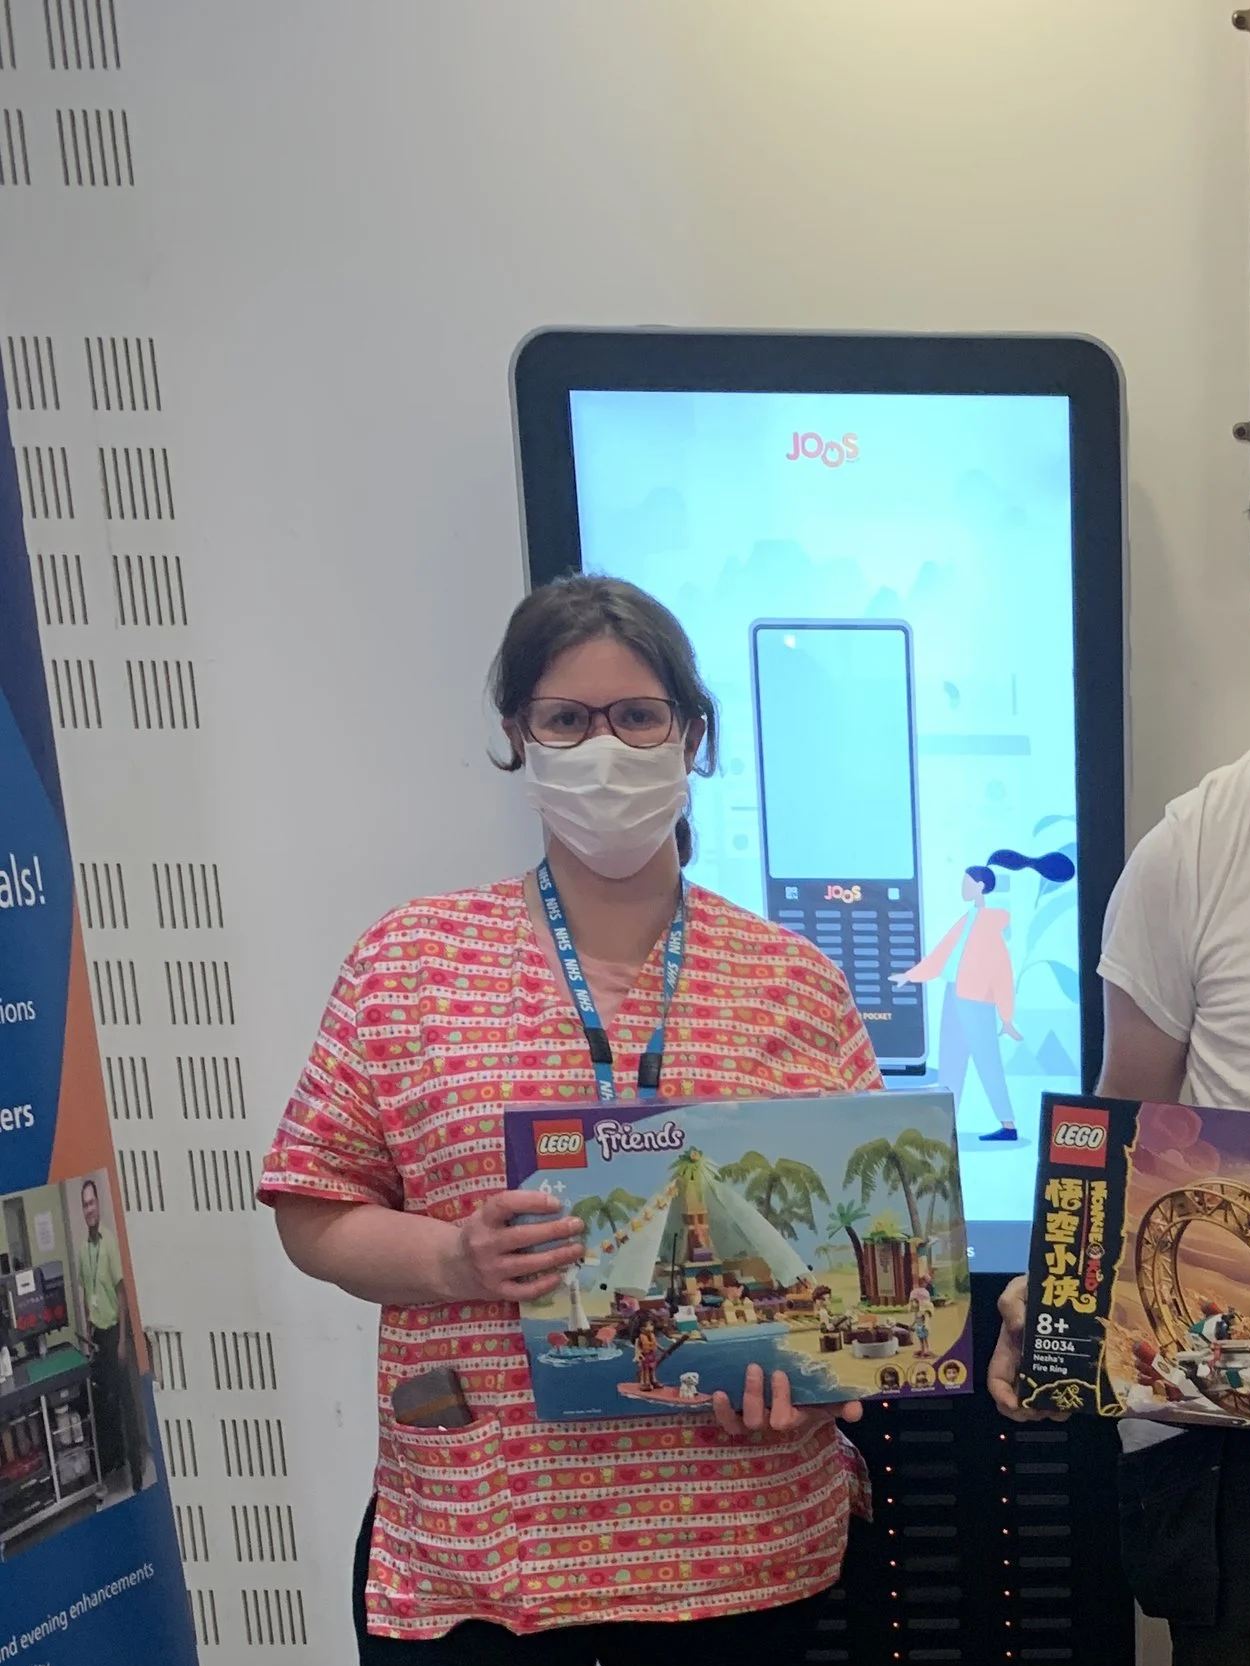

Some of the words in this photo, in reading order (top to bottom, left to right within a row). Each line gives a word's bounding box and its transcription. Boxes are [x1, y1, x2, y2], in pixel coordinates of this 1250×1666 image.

[785, 431, 859, 468] JOOS
[824, 884, 862, 904] JOOS
[554, 926, 573, 951] NHS
[668, 929, 682, 955] NHS
[563, 958, 583, 982] NHS
[666, 960, 680, 989] NHS
[574, 988, 595, 1013] NHS
[538, 1132, 583, 1155] LEGO
[594, 1119, 685, 1162] Friends
[1053, 1122, 1105, 1149] LEGO
[1036, 1312, 1070, 1335] 8+
[1034, 1338, 1076, 1352] 80034
[1032, 1363, 1048, 1372] Fire
[1049, 1364, 1069, 1376] Ring
[1033, 1353, 1065, 1364] Nezha's
[20, 1610, 69, 1650] evening
[69, 1563, 155, 1620] enhancements
